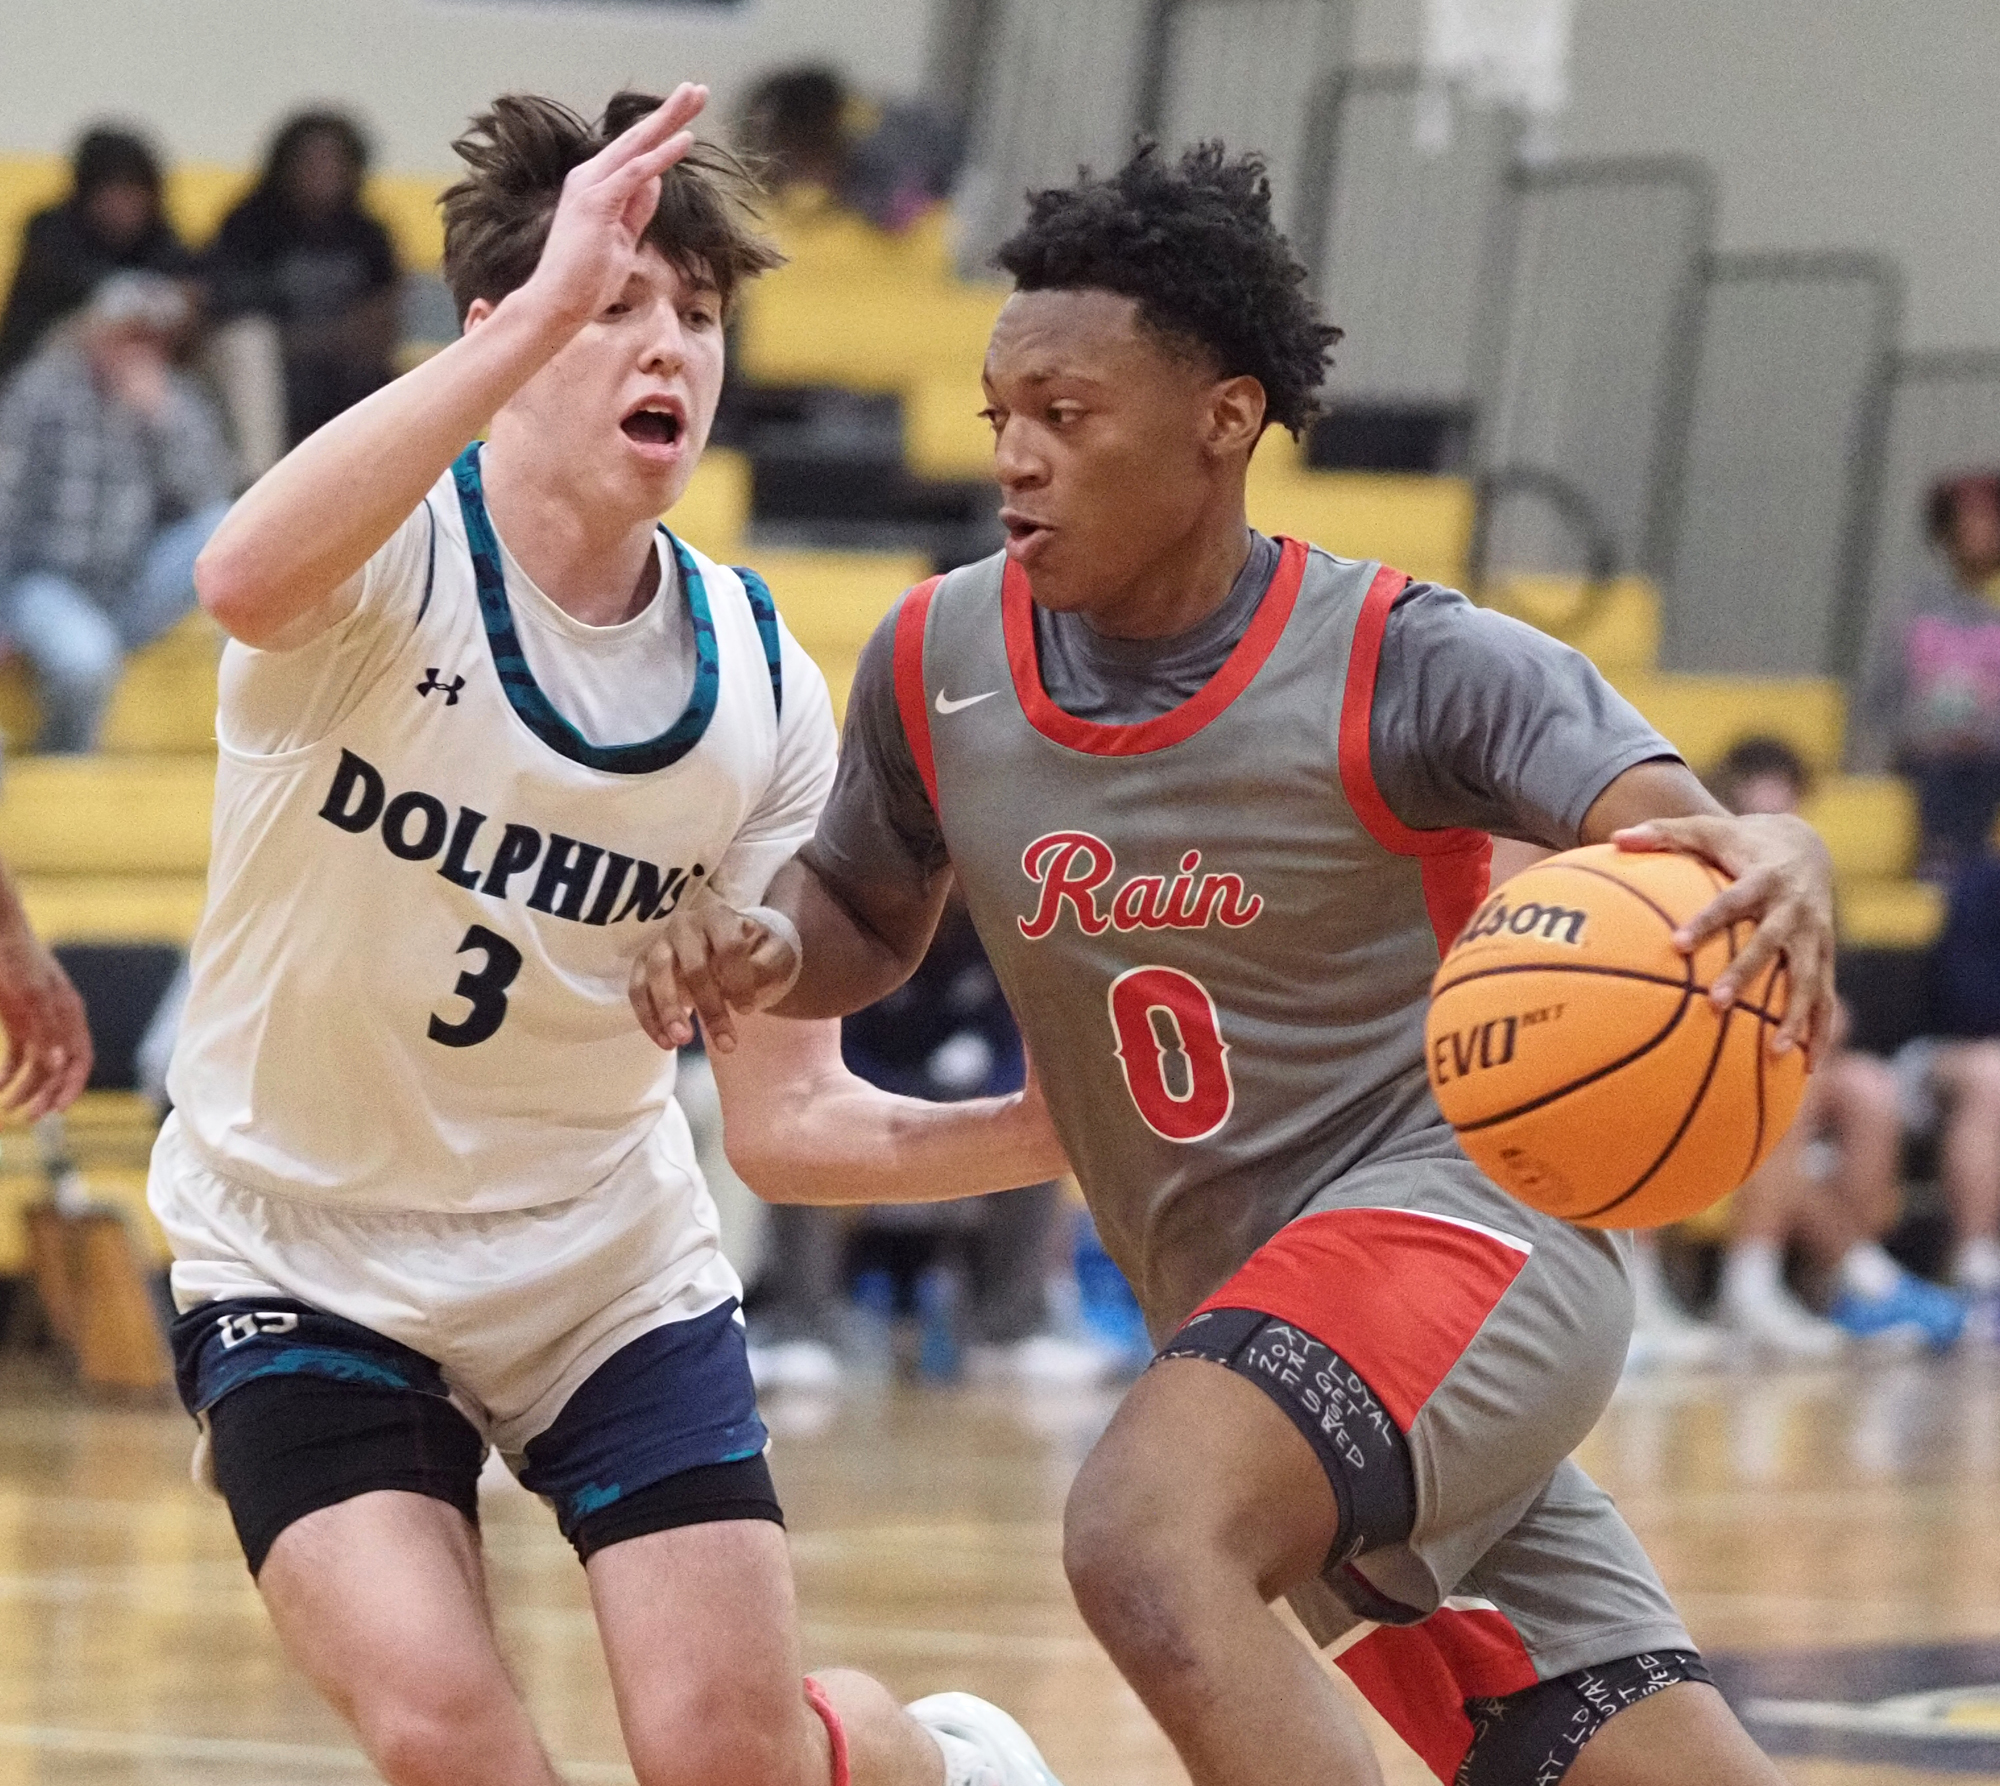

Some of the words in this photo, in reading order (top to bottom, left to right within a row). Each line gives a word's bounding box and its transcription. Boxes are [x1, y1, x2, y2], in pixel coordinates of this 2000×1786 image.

[1017, 830, 1264, 940] Rain
[426, 924, 523, 1048] 3
[1107, 965, 1232, 1143] 0
[1434, 1015, 1517, 1085] EVO
[1315, 1371, 1361, 1416] GET
[1328, 1356, 1392, 1446] LOYAL
